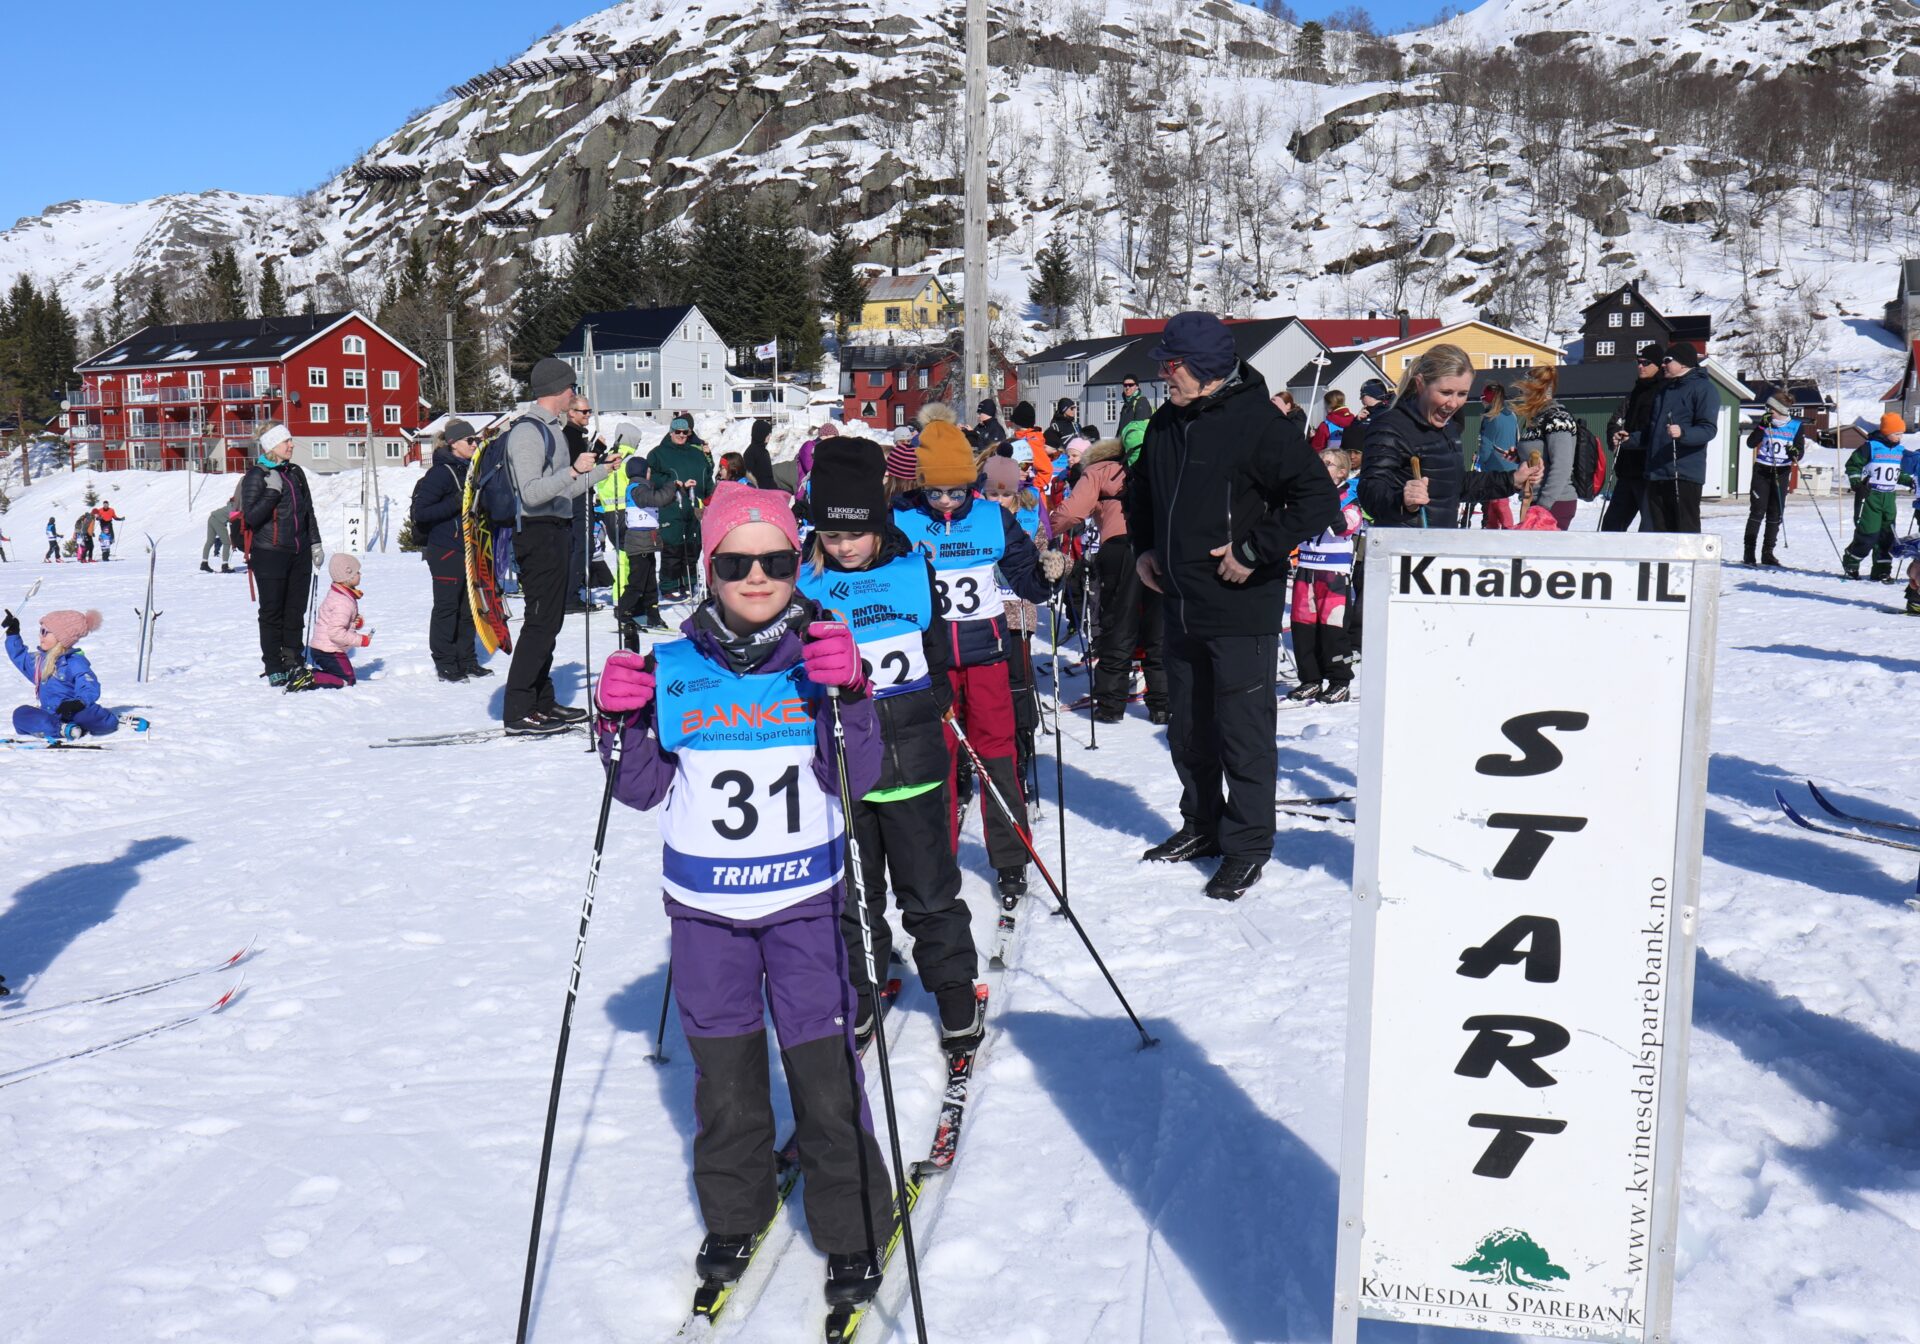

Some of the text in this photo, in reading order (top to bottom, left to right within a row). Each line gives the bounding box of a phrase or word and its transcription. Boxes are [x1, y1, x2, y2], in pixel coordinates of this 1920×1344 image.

[638, 513, 648, 521] 57
[939, 547, 993, 558] HUNSBEDT AS
[940, 542, 968, 551] ANTON
[1399, 556, 1687, 603] Knaben IL
[852, 604, 888, 618] ANTON
[702, 727, 812, 742] Kvinesdal Sparebank
[711, 765, 801, 841] 31
[712, 857, 813, 886] TRIMTEX
[1454, 710, 1590, 1180] START
[1625, 876, 1668, 1274] www.kvinesdalsparebank.no
[1361, 1276, 1643, 1326] KVINESDAL SPAREBANK
[1465, 1312, 1488, 1323] 38
[1532, 1319, 1555, 1331] 88
